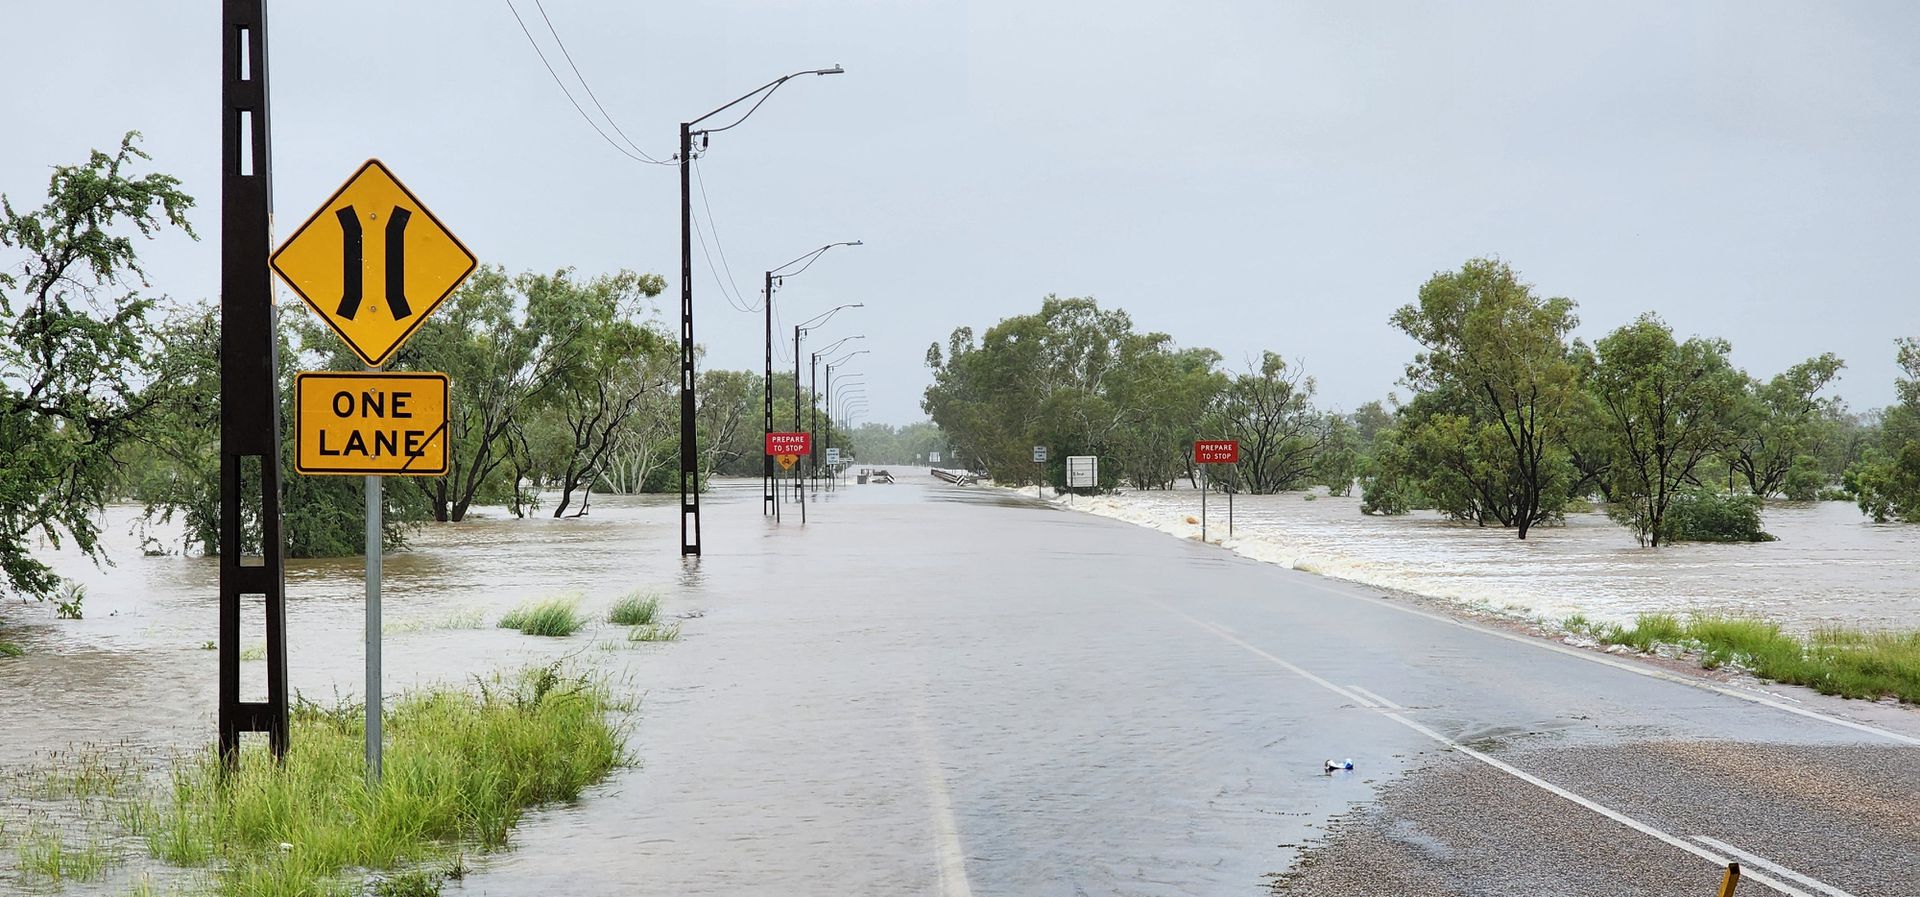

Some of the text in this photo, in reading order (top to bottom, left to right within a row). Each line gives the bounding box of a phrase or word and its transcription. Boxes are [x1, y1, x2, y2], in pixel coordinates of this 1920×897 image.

[333, 391, 412, 419] ONE
[319, 429, 425, 457] LANE
[774, 444, 783, 452] TO
